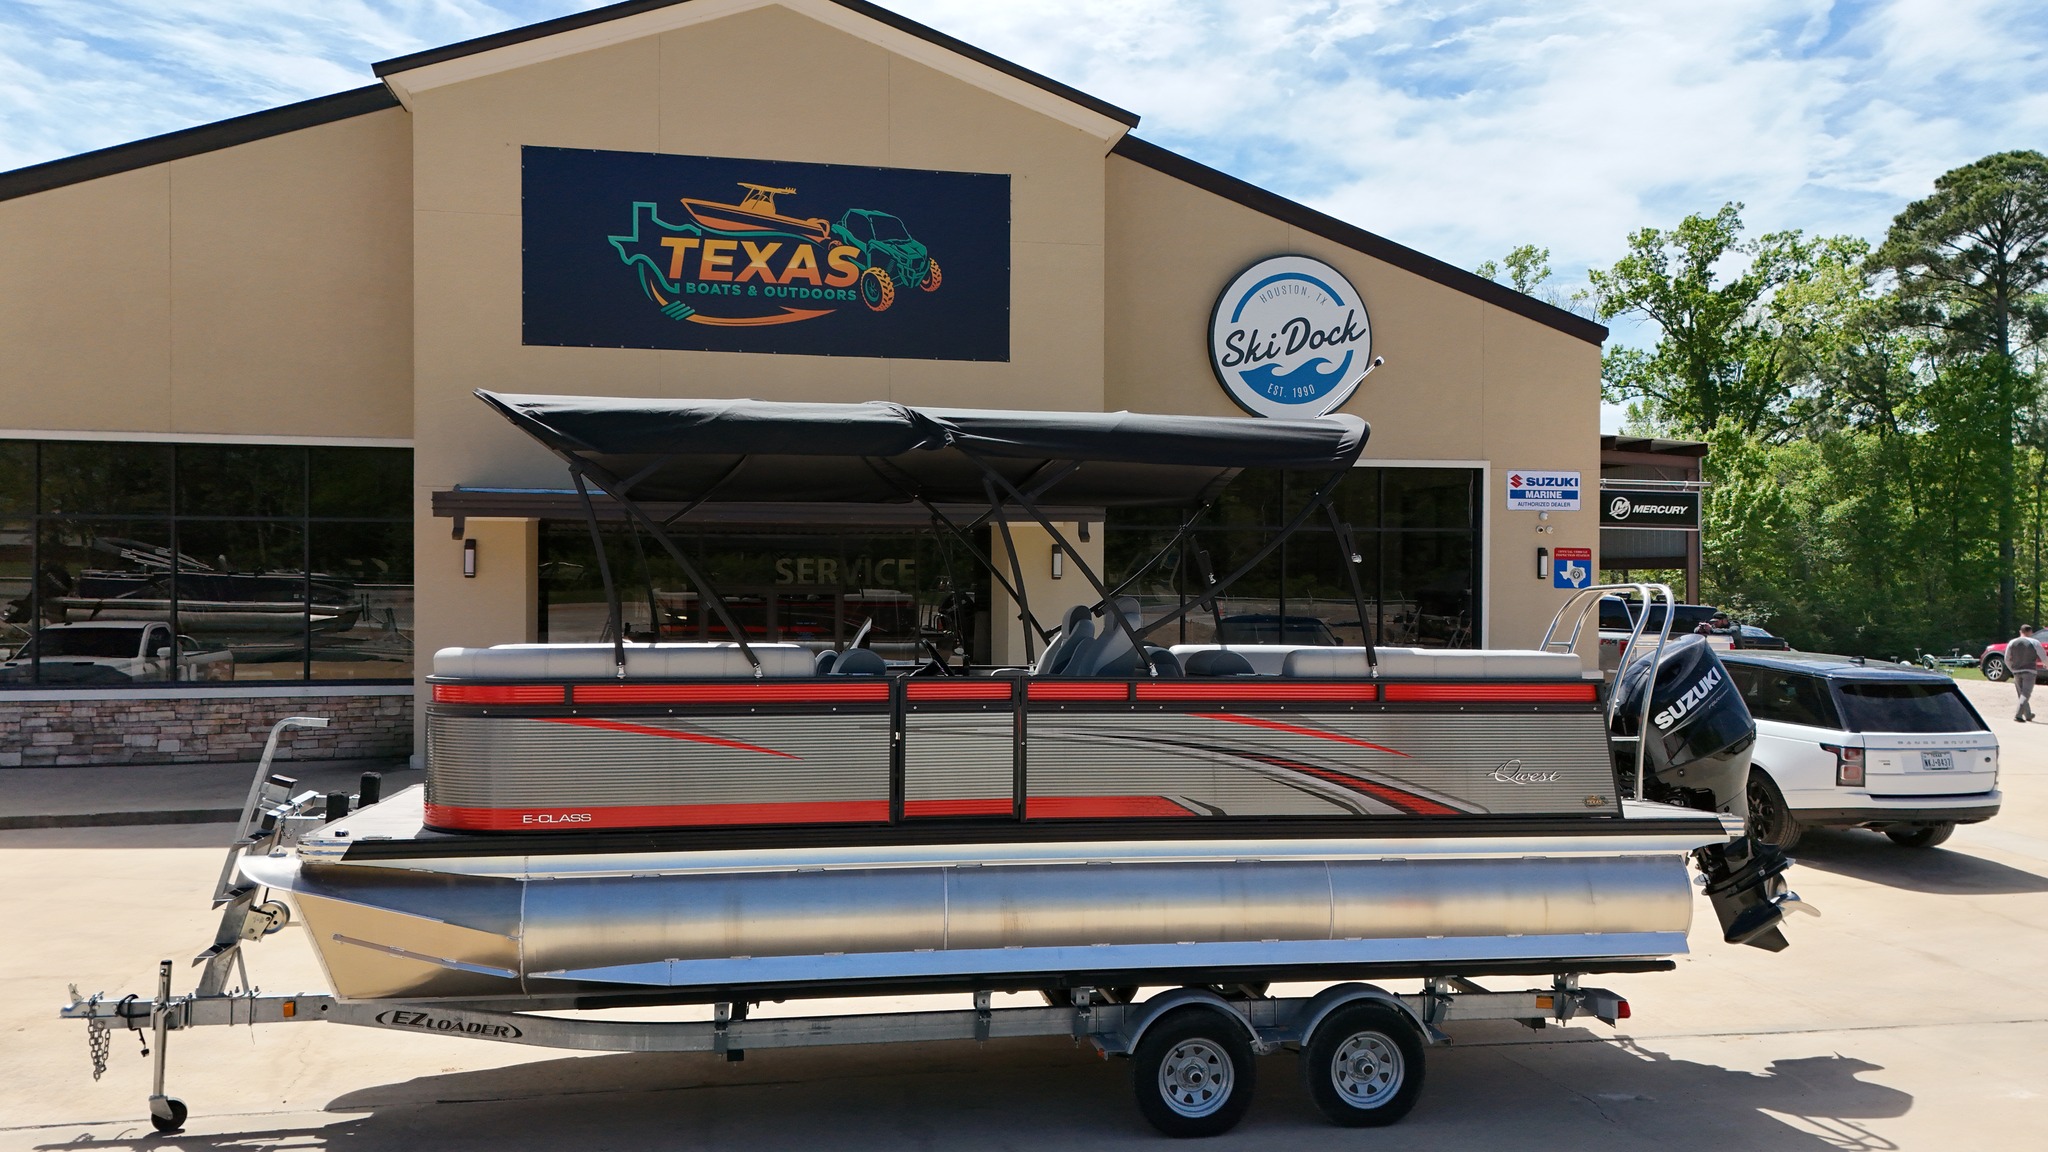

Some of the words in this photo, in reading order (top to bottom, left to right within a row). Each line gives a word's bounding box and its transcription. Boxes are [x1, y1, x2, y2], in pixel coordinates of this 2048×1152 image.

[660, 237, 861, 288] TEXAS
[685, 282, 741, 296] BOATS
[747, 284, 758, 297] &
[764, 286, 857, 301] OUTDOORS
[1259, 284, 1310, 304] HOUSTON,
[1315, 293, 1328, 306] TX
[1221, 329, 1281, 367] Ski
[1281, 308, 1366, 357] Dock
[1267, 383, 1287, 398] EST.
[1292, 383, 1316, 398] 1990
[1526, 477, 1579, 487] SUZUKI
[1525, 490, 1562, 499] MARINE
[1632, 504, 1689, 515] MERCURY
[775, 558, 916, 586] SERVICE
[1654, 666, 1722, 730] SUZUKI
[1486, 759, 1561, 785] Qwest
[523, 813, 592, 824] E-CLASS
